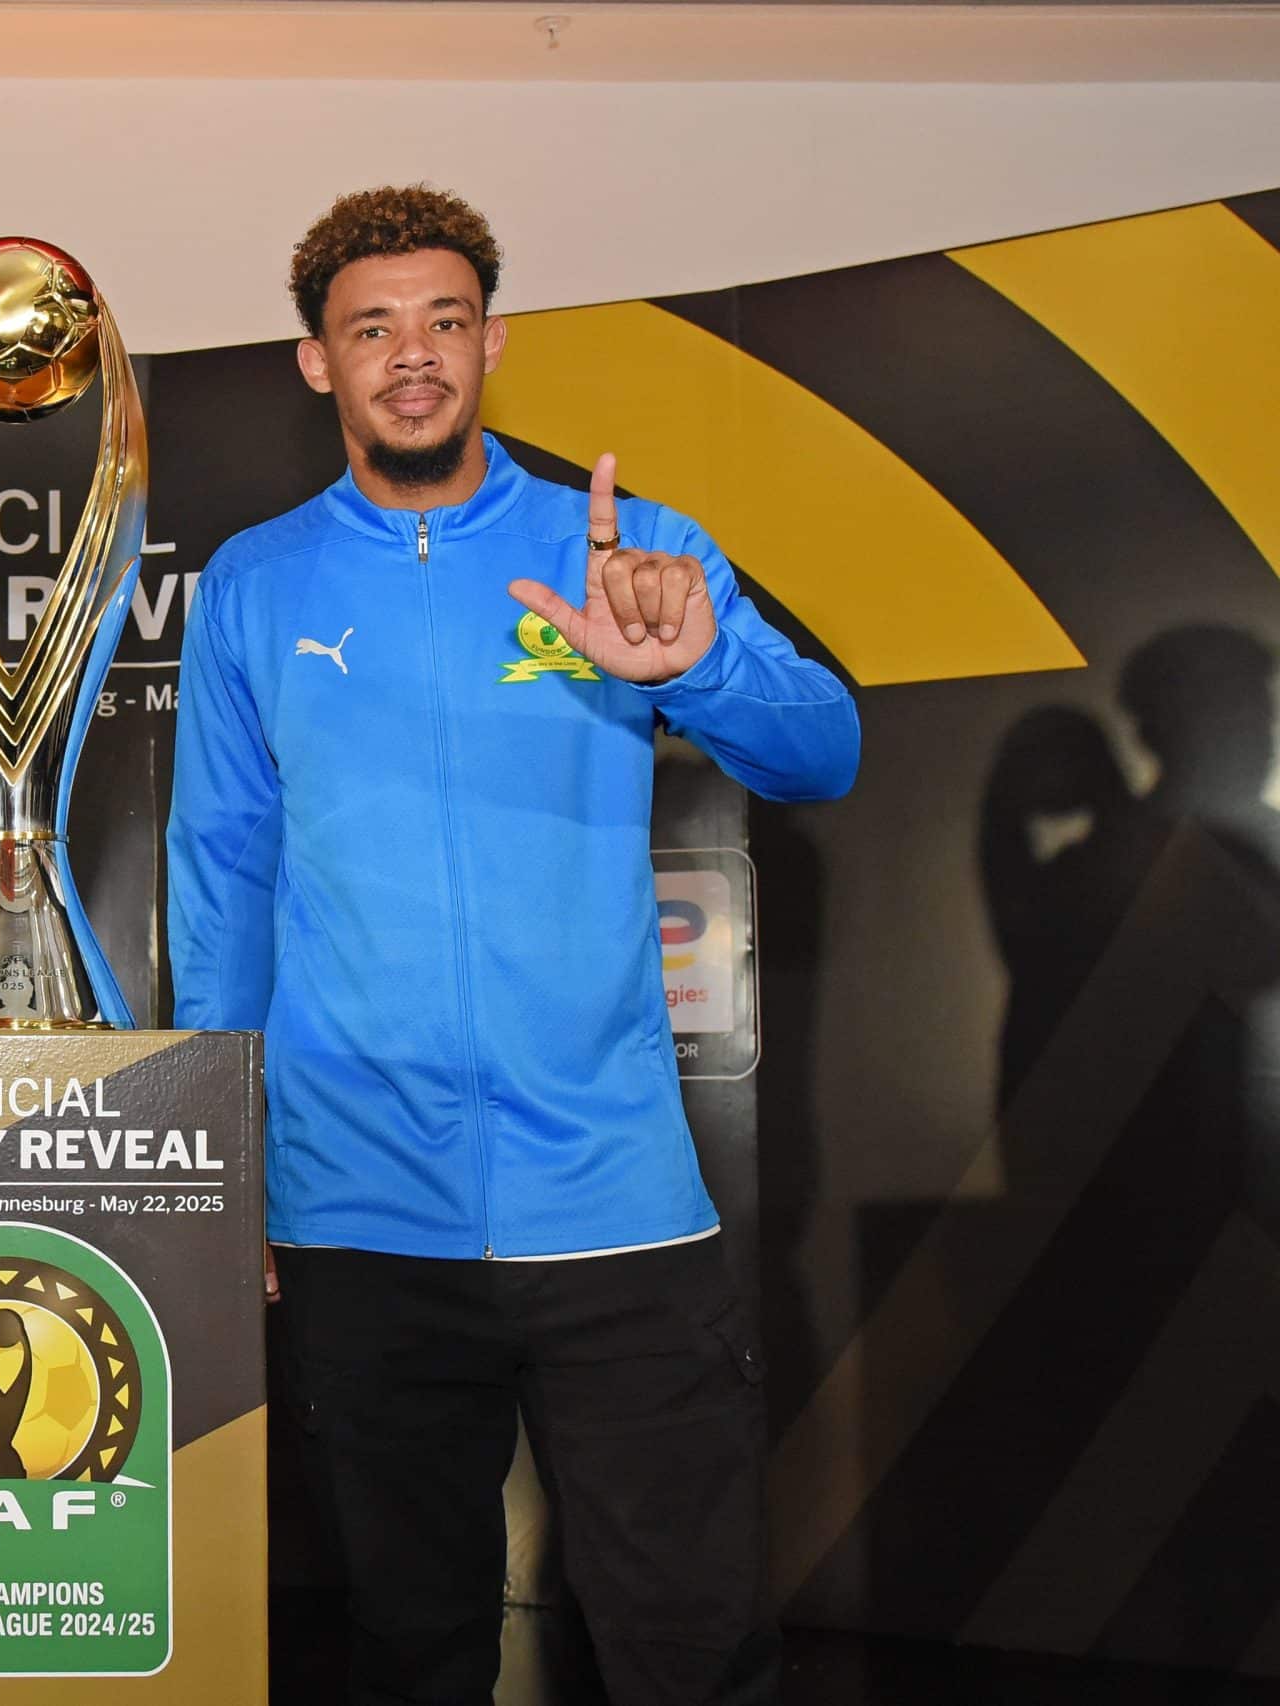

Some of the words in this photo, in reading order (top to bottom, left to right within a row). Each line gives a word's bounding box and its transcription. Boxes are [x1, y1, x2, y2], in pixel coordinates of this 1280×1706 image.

[20, 1129, 224, 1169] REVEAL
[100, 1195, 138, 1215] May
[142, 1195, 171, 1215] 22,
[174, 1195, 224, 1212] 2025
[60, 1612, 156, 1637] 2024/25
